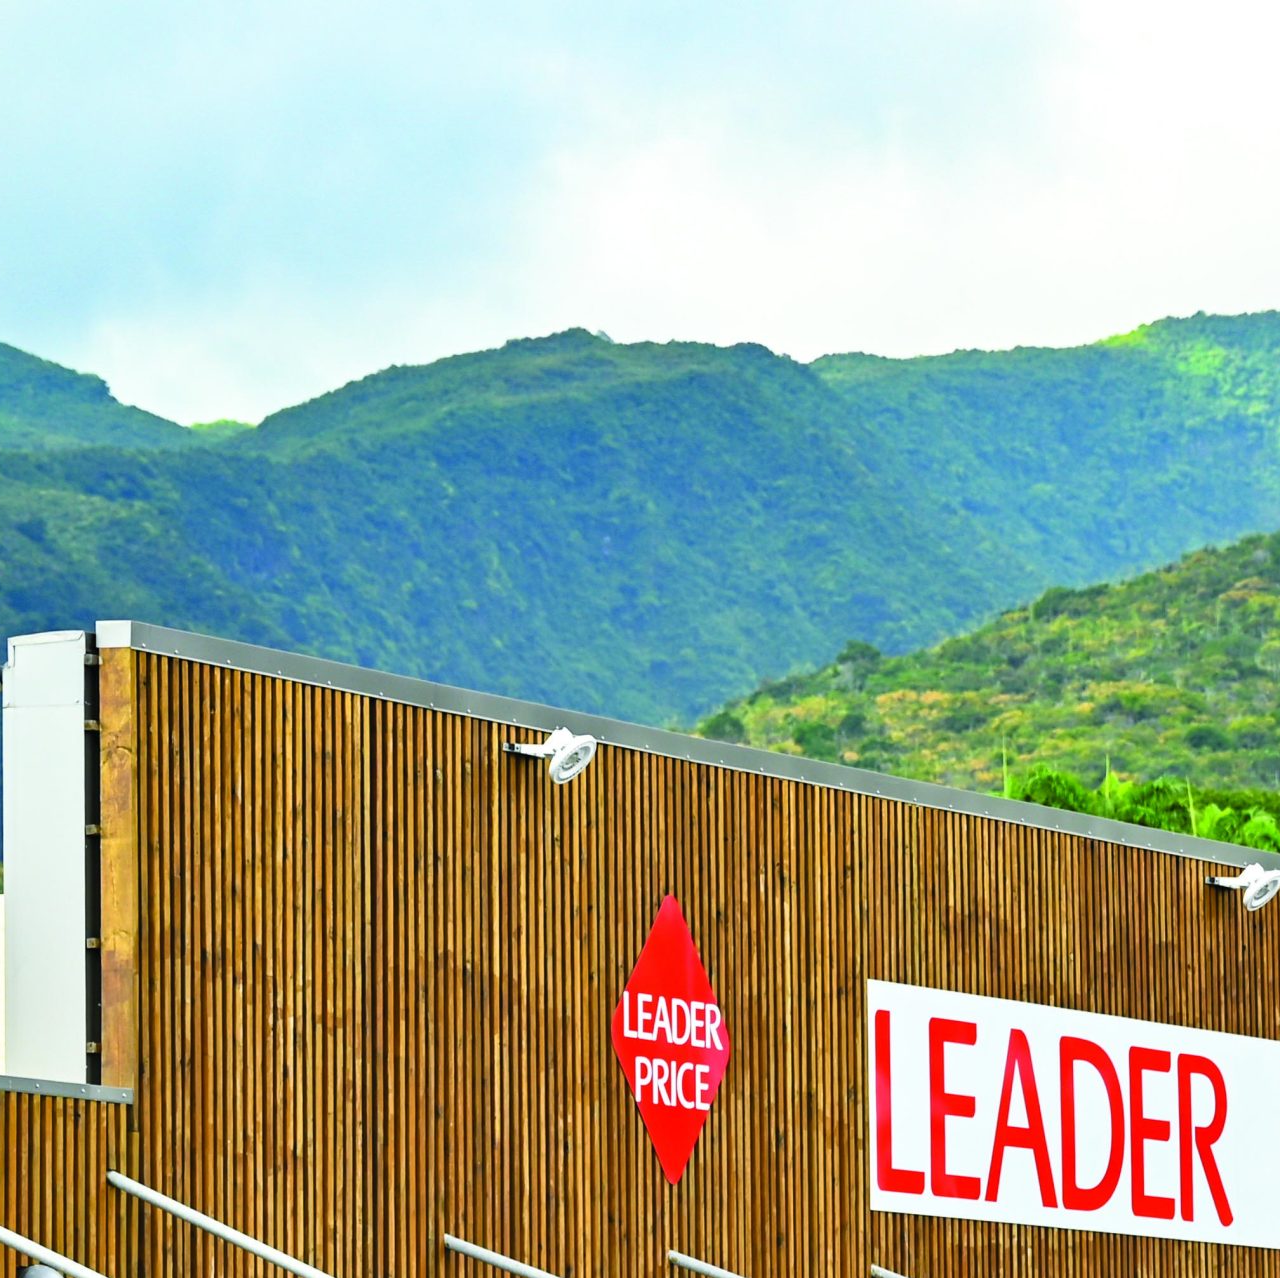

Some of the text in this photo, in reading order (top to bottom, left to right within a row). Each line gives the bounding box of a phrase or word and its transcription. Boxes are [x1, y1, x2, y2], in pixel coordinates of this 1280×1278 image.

[623, 990, 724, 1051] LEADER
[634, 1056, 711, 1111] PRICE
[874, 1008, 1234, 1227] LEADER
